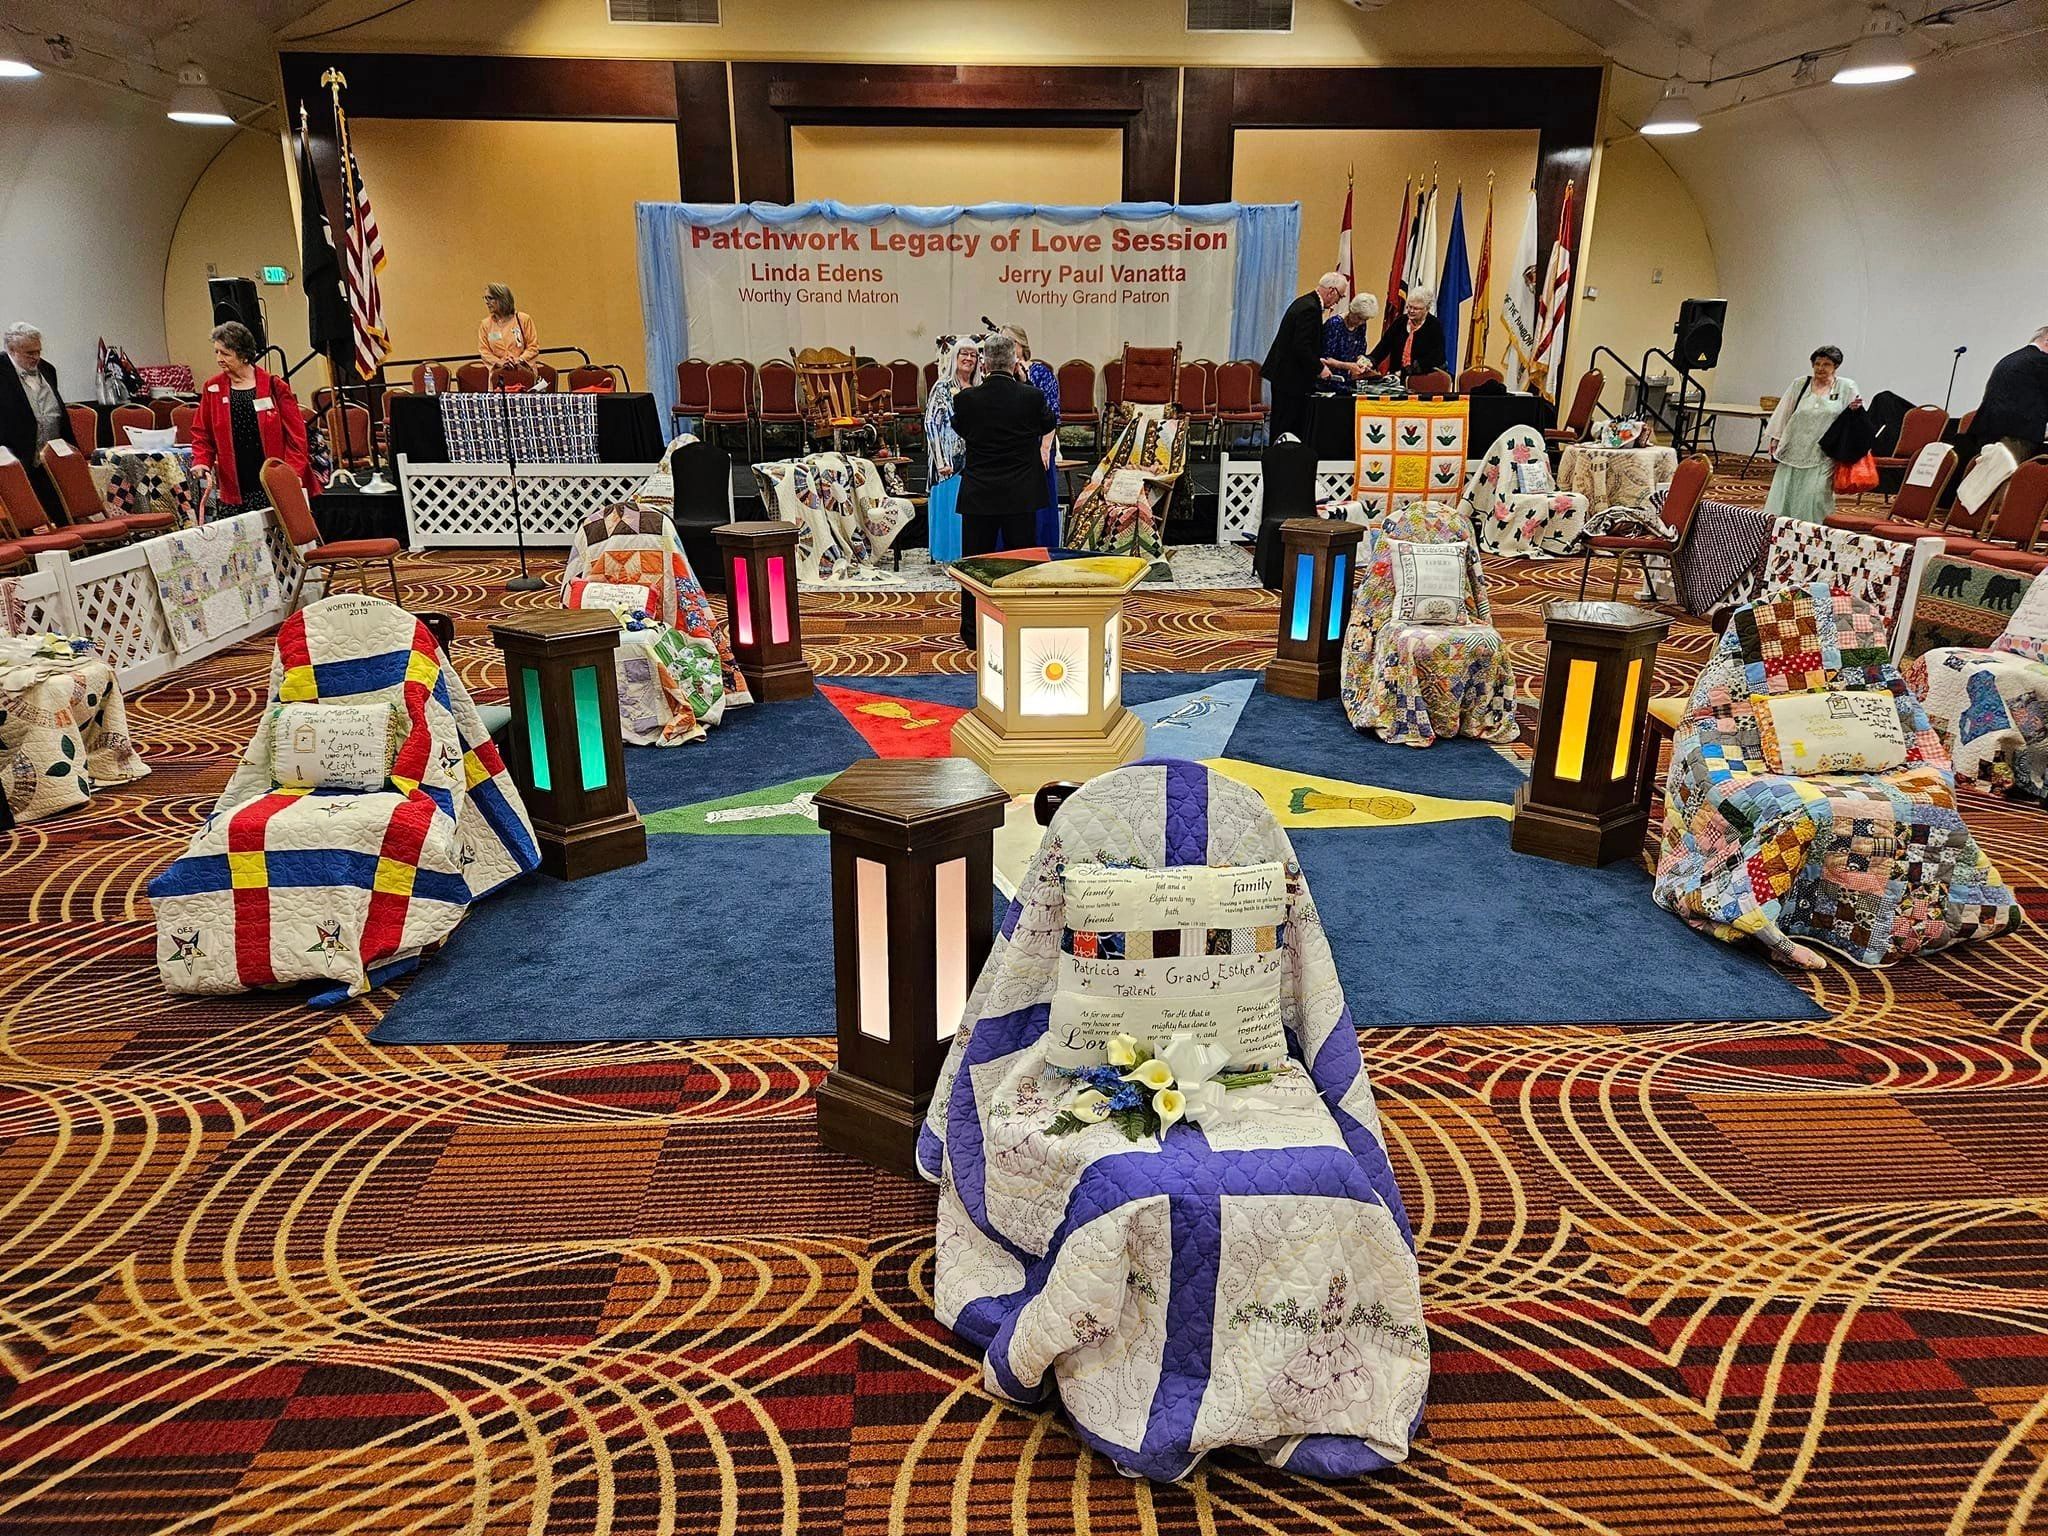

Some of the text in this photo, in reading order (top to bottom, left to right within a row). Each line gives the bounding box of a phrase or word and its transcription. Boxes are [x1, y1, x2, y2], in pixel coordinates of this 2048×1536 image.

[691, 226, 1228, 258] Patchwork Legacy of Love Session
[751, 262, 884, 282] Linda Edens
[998, 264, 1187, 288] Jerry Paul Vanatta
[738, 288, 899, 306] Worthy Grand Matron
[1016, 289, 1170, 307] Worthy Grand Patron
[326, 602, 356, 612] WORTHY
[349, 608, 368, 616] 2013
[1167, 882, 1181, 890] and
[1231, 876, 1273, 899] family
[1080, 886, 1115, 901] family
[1185, 897, 1197, 906] my
[1082, 912, 1115, 928] friends
[177, 926, 194, 935] OES
[1072, 958, 1120, 976] Patricia
[1090, 1010, 1100, 1020] for
[1110, 1010, 1125, 1018] and
[1161, 1009, 1176, 1019] For
[1188, 1009, 1203, 1018] that
[1241, 1015, 1255, 1023] are
[1151, 1020, 1217, 1032] mighty has done to
[1237, 1023, 1271, 1036] together
[1060, 1023, 1108, 1050] Lor
[1203, 1030, 1218, 1039] and
